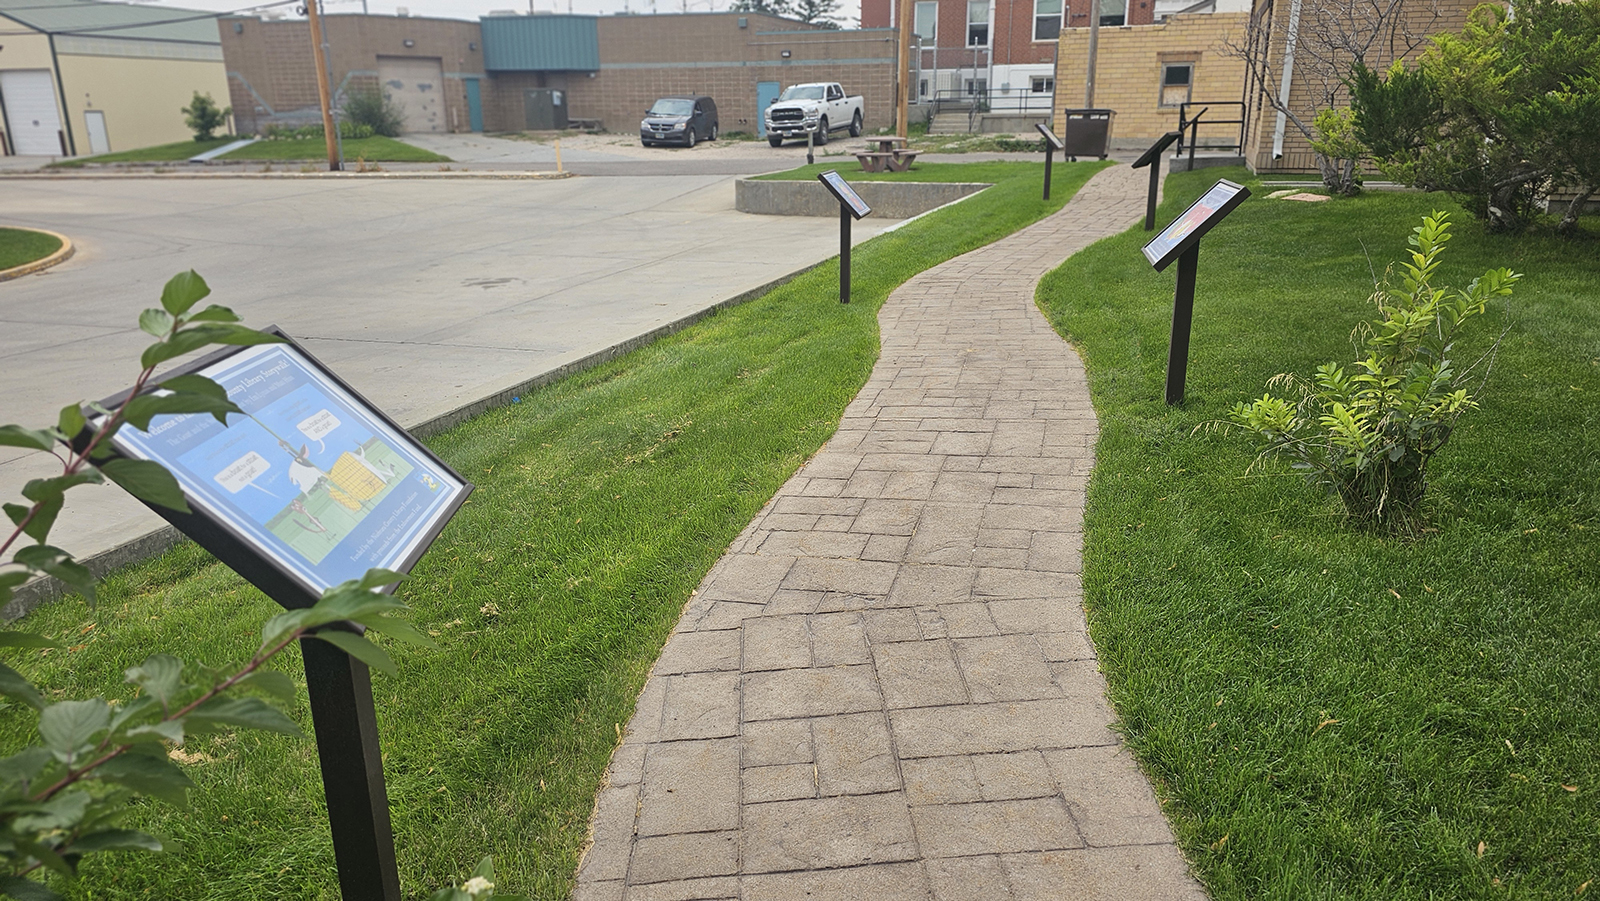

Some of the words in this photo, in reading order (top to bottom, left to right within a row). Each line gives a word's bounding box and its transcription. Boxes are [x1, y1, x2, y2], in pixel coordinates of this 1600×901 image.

[173, 414, 188, 423] to
[223, 384, 249, 399] ounty
[239, 372, 268, 390] Library
